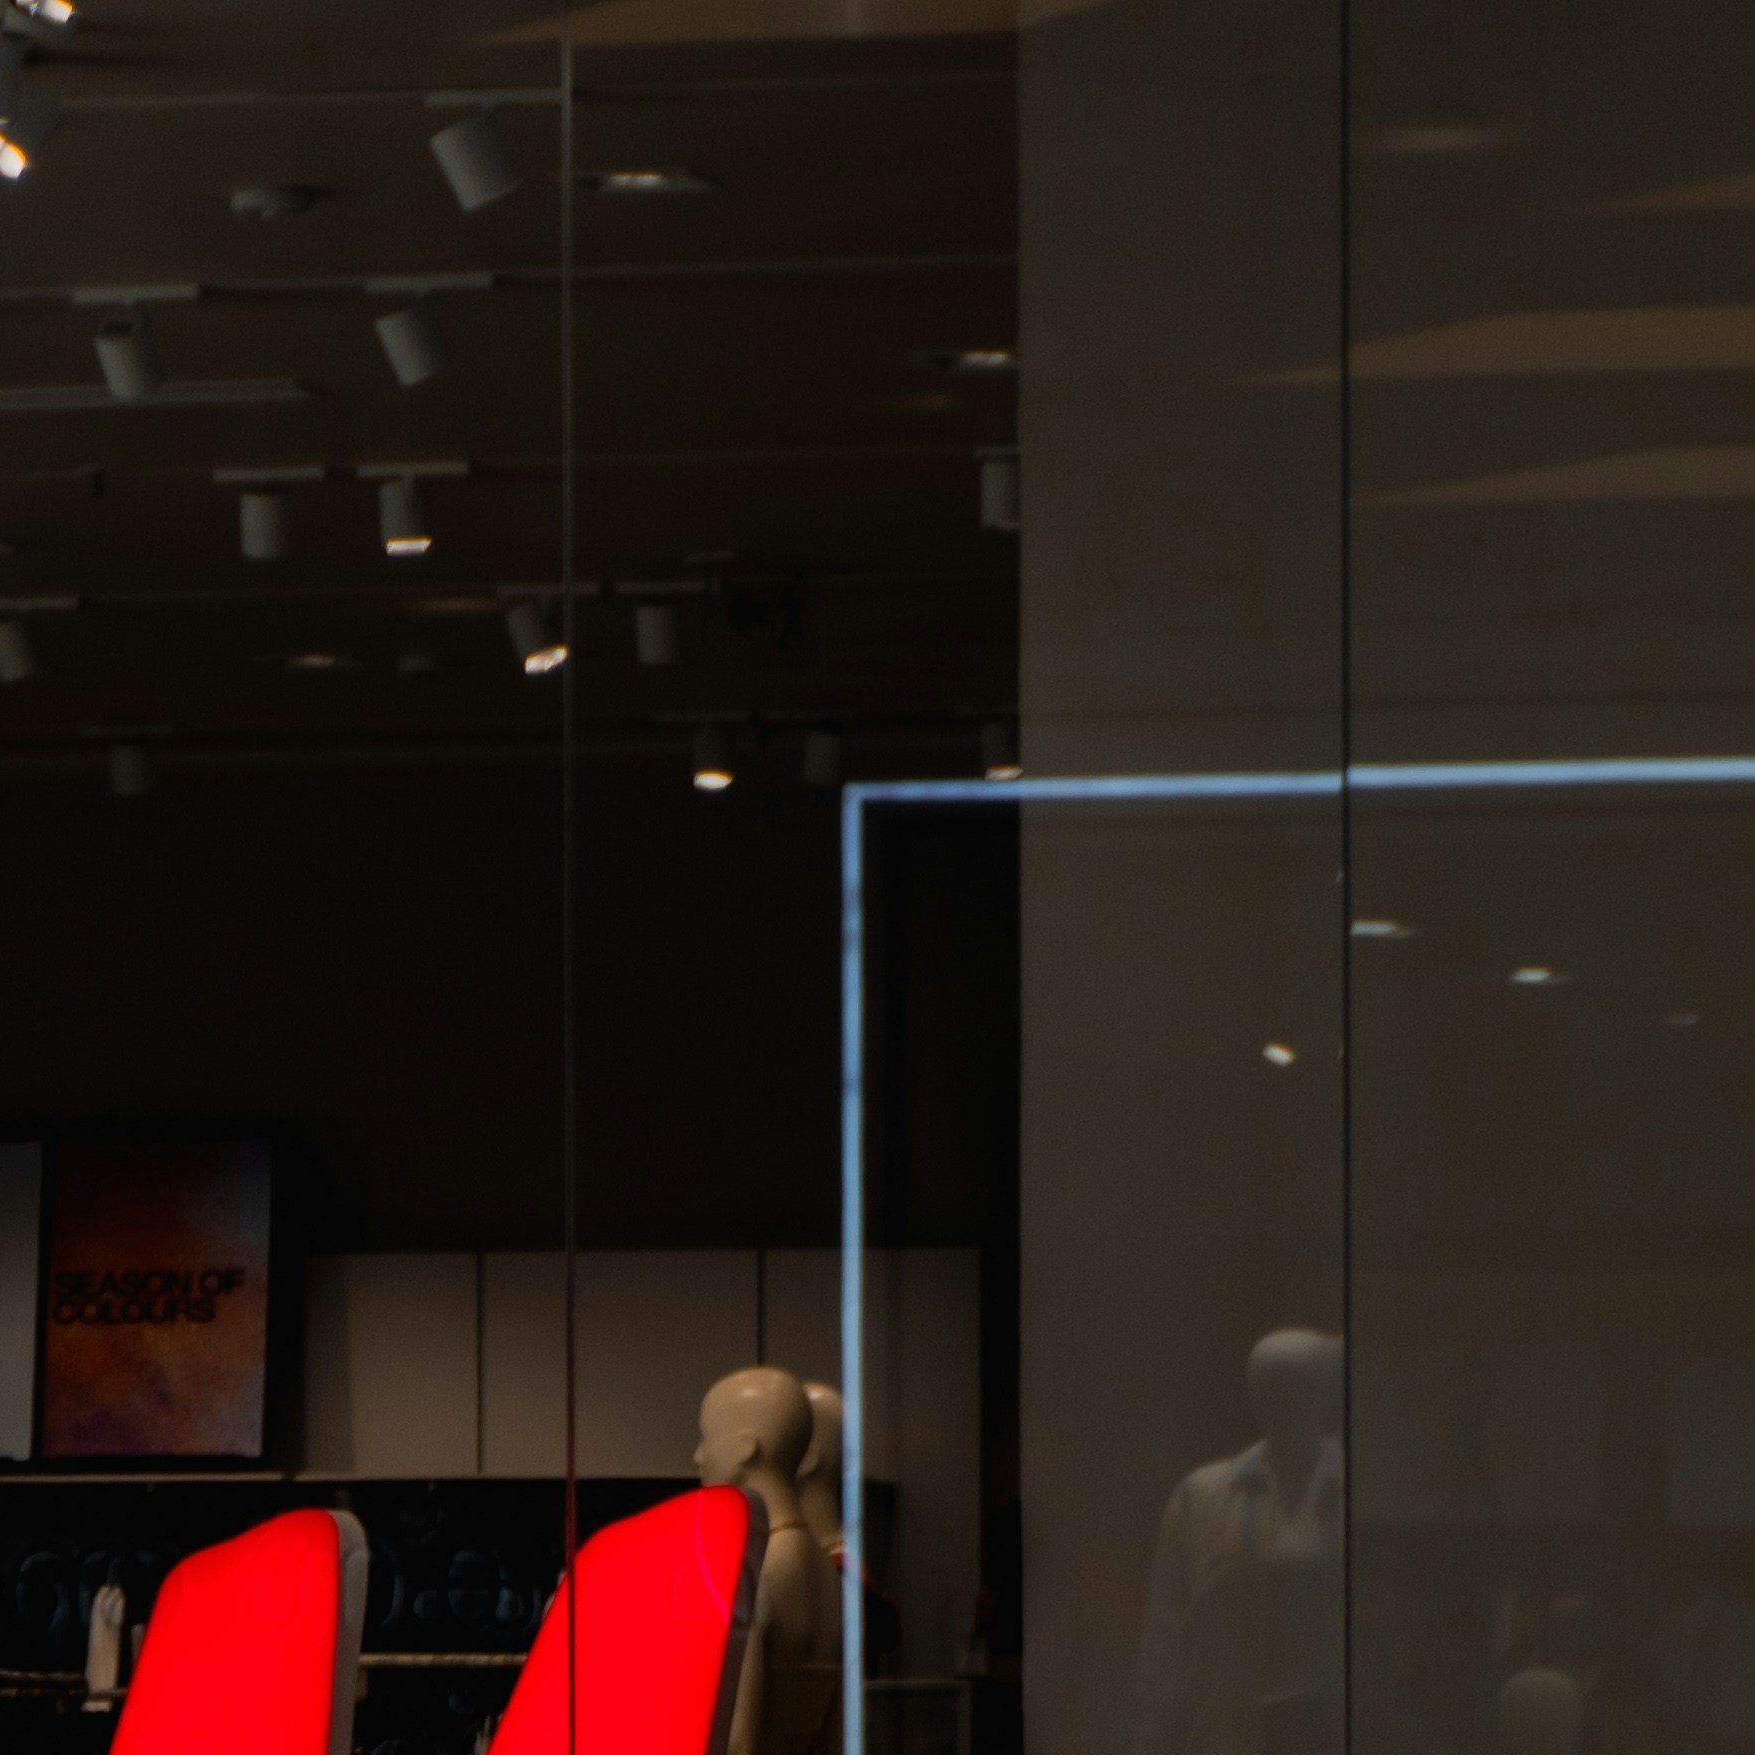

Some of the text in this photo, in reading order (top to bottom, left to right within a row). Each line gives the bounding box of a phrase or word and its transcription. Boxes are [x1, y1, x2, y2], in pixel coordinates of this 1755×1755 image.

[54, 1268, 245, 1299] SEASON OF
[53, 1299, 215, 1325] COLOURS
